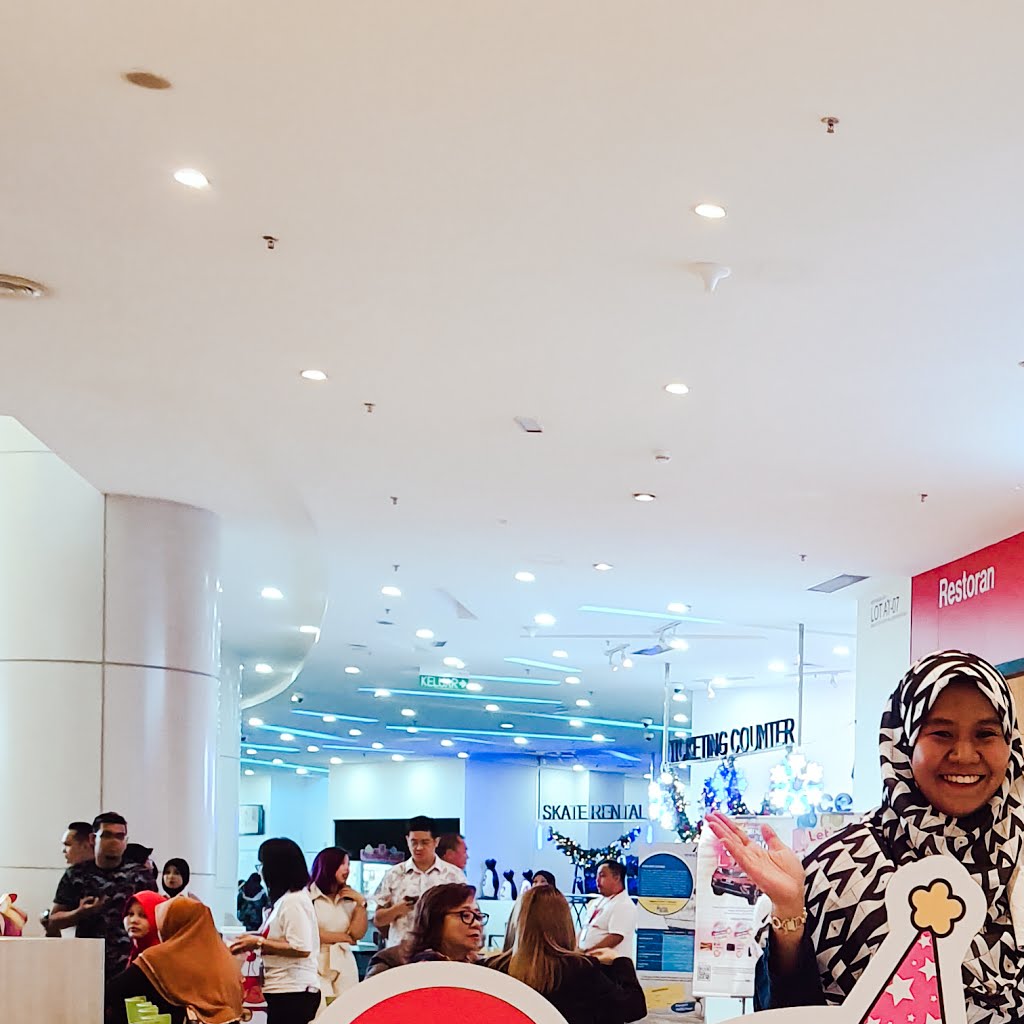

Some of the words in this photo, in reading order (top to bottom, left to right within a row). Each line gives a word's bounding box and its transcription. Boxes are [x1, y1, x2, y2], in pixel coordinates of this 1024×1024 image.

[938, 566, 996, 609] Restoran
[669, 731, 729, 763] TICKETING
[730, 718, 796, 755] COUNTER
[542, 804, 588, 820] SKATE
[591, 804, 647, 820] RENTAL
